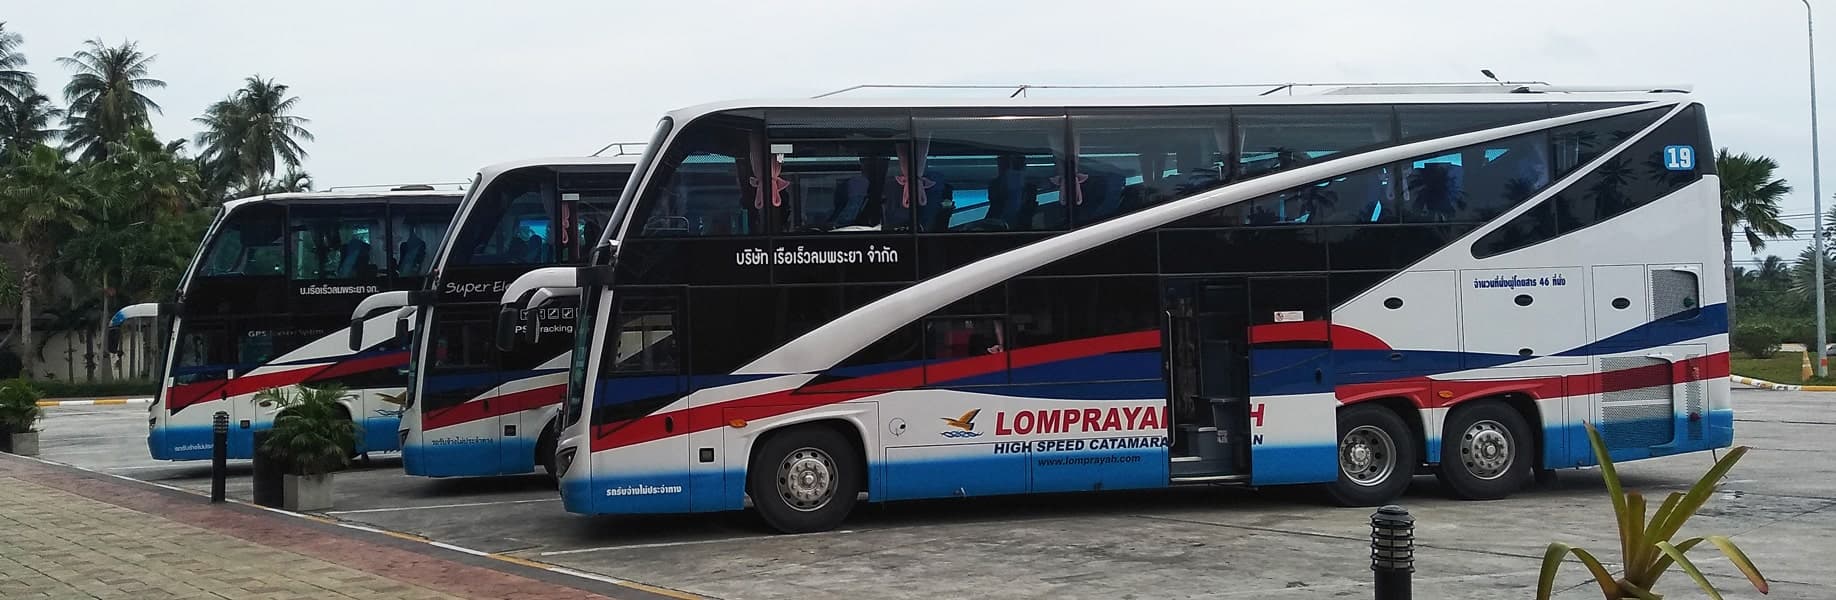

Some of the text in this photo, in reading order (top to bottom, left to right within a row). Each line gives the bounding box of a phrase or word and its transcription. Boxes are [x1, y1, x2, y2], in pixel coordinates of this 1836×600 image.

[1668, 147, 1691, 168] 19
[736, 245, 898, 265] บริษัท เรือเร็วลมพระยา จำกัด
[445, 281, 491, 297] Super
[1539, 277, 1550, 286] 46
[540, 324, 573, 334] racking
[994, 441, 1032, 455] HIGH
[1036, 438, 1085, 453] SPEED
[1038, 454, 1142, 466] www.lomprayah.com
